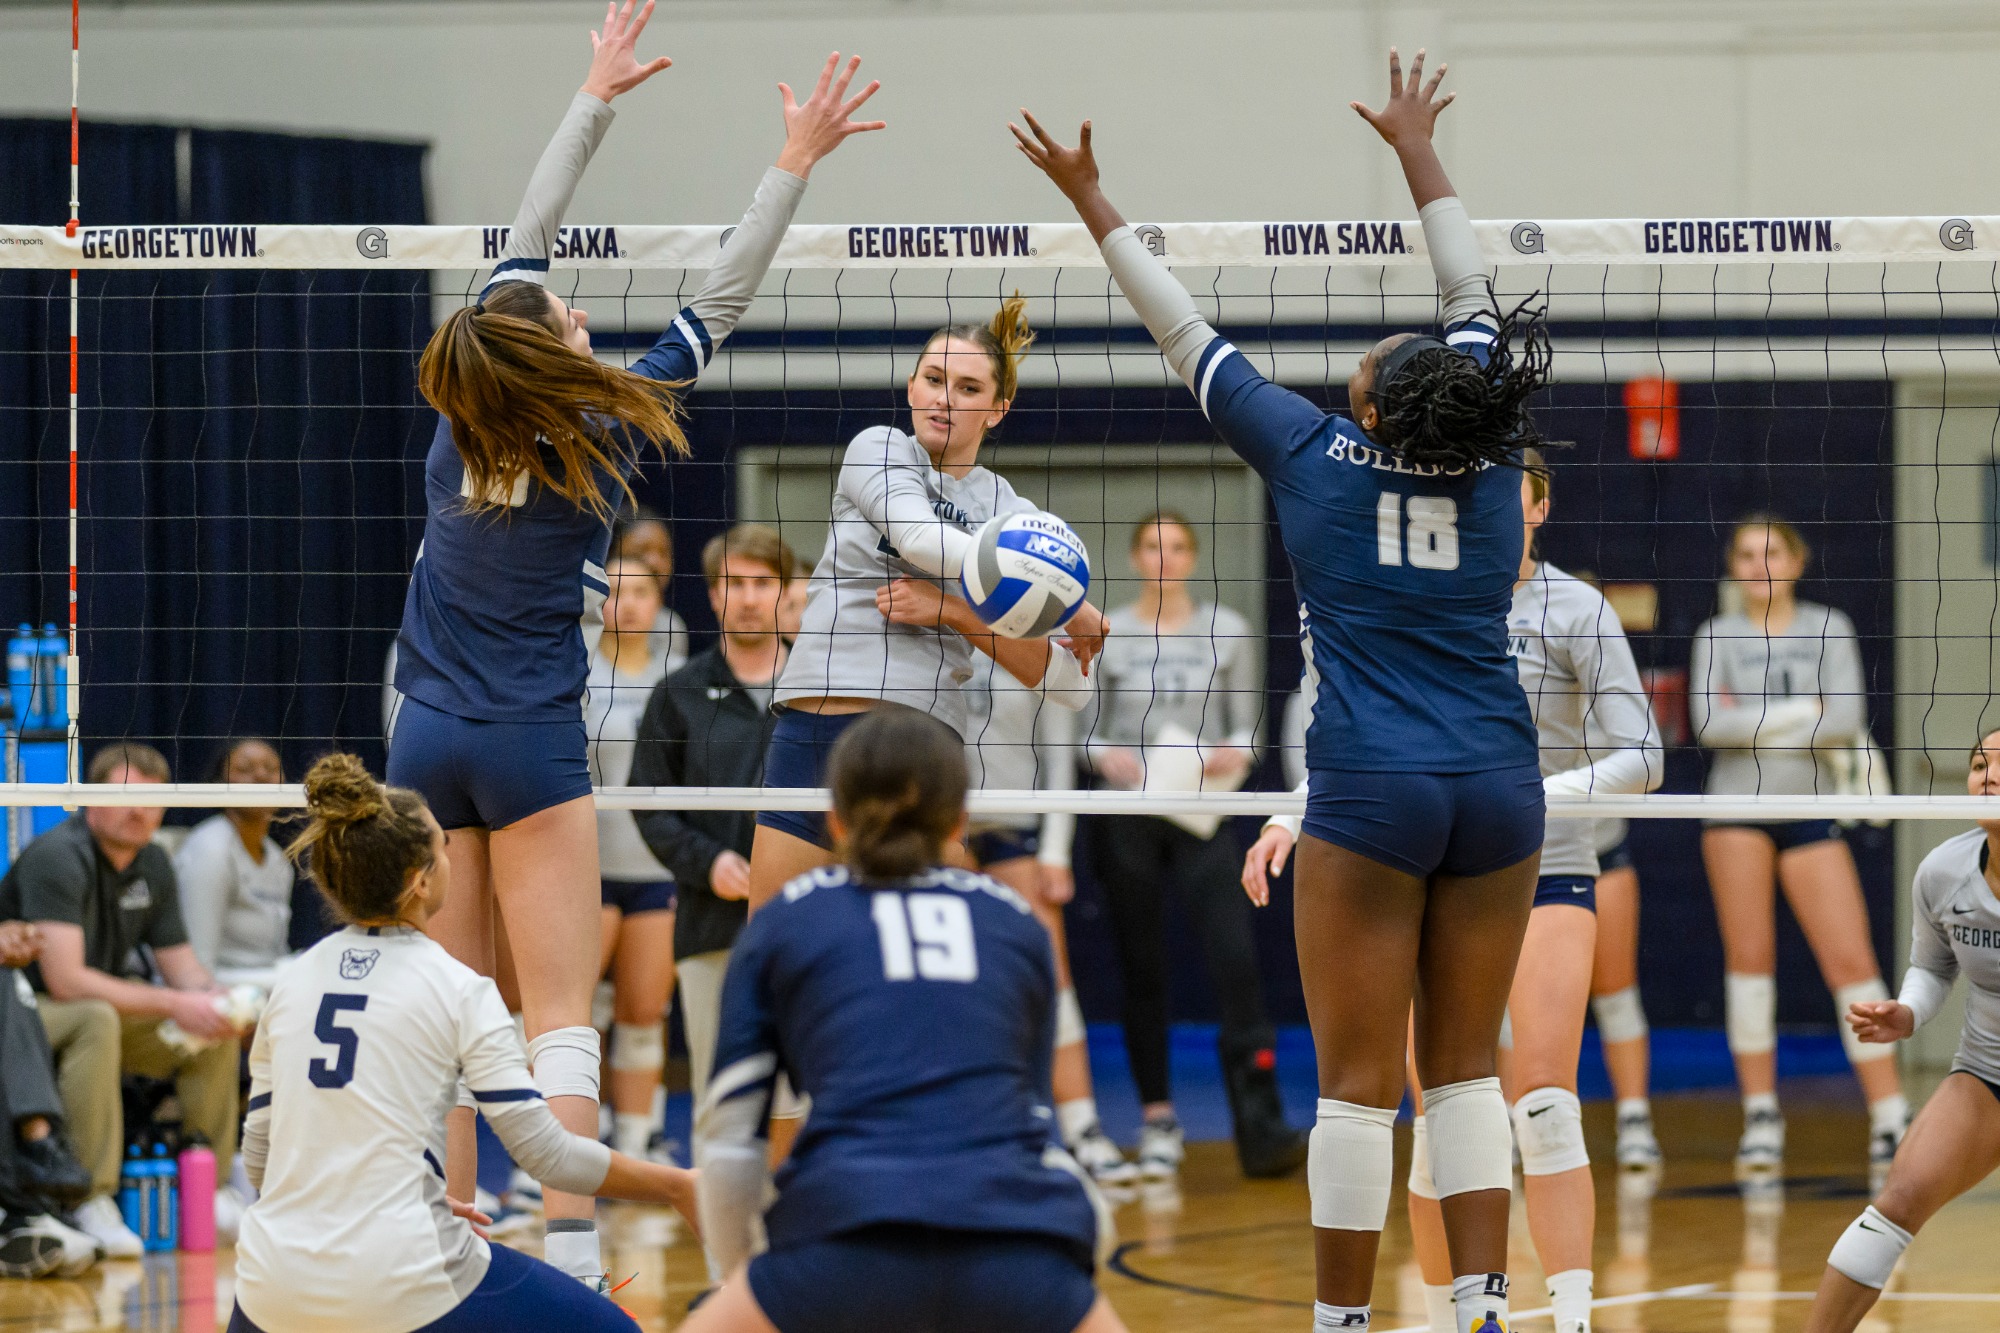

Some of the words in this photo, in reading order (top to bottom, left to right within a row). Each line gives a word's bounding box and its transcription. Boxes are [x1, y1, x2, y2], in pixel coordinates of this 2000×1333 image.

[82, 227, 257, 259] GEORGETOWN
[554, 227, 619, 259] SAXA
[849, 226, 1030, 258] GEORGETOWN
[1264, 223, 1330, 256] HOYA
[1338, 222, 1406, 255] SAXA
[1644, 220, 1832, 253] GEORGETOWN
[1022, 519, 1084, 555] molten
[1377, 491, 1460, 570] 18
[1024, 533, 1081, 573] NCAA
[872, 891, 978, 983] 19
[308, 993, 369, 1089] 5
